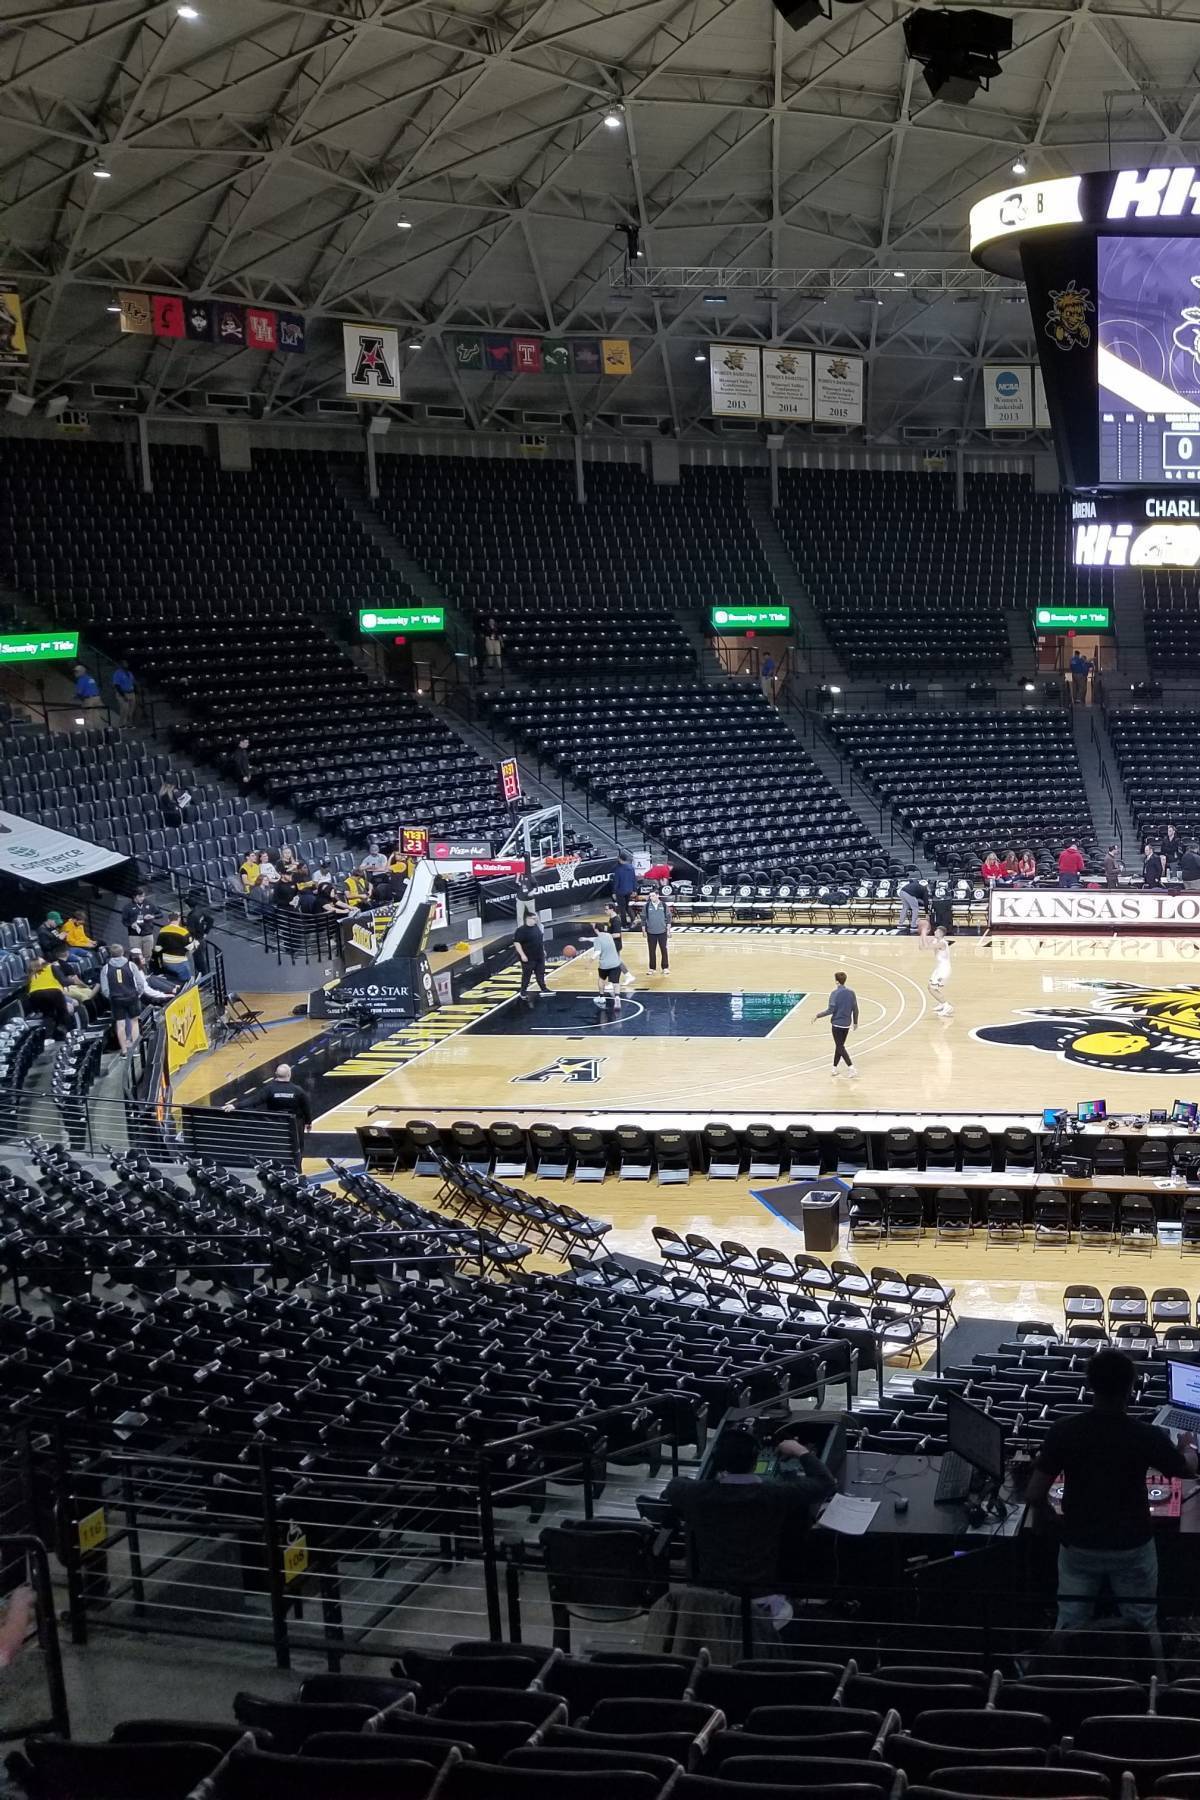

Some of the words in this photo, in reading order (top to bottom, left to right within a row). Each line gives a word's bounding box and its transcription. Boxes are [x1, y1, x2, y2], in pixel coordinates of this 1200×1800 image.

[352, 335, 394, 387] A
[728, 400, 747, 410] 2013
[779, 404, 798, 413] 2014
[829, 408, 848, 417] 2015
[999, 413, 1019, 421] 2013
[1178, 437, 1192, 460] 0
[407, 840, 422, 851] 23
[470, 847, 486, 855] Hut
[10, 848, 85, 871] Commerce
[44, 859, 87, 875] Bank
[998, 897, 1141, 919] KANSAS
[671, 925, 899, 936] OSHOCKERS.COM
[381, 985, 409, 996] STAR
[287, 1550, 305, 1570] 108
